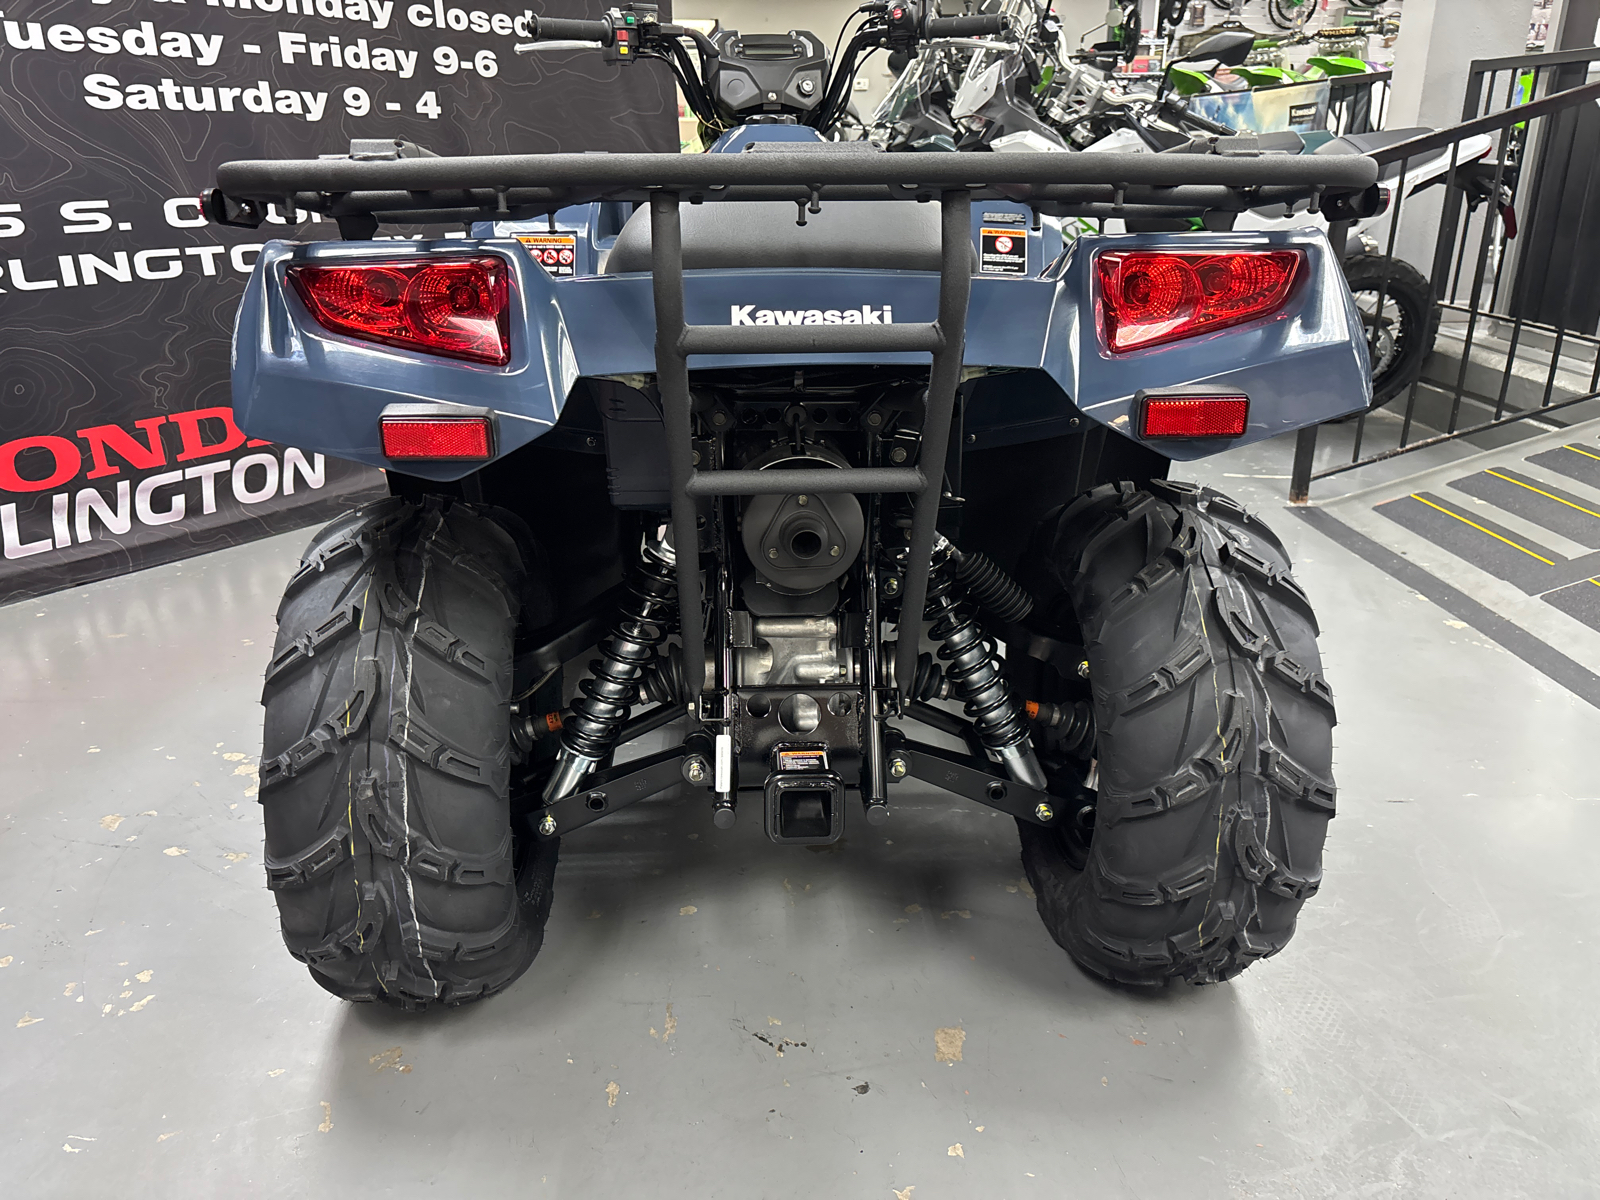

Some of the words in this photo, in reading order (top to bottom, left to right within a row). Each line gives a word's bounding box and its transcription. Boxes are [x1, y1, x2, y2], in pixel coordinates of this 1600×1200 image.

[206, 0, 394, 29] onday
[407, 0, 534, 38] closed
[0, 11, 224, 66] uesday
[278, 31, 418, 79] Friday
[433, 46, 499, 78] 9-6
[83, 73, 328, 122] Saturday
[343, 86, 371, 117] 9
[415, 91, 442, 119] 4
[59, 200, 133, 234] S.
[731, 304, 893, 327] Kawasaki
[0, 406, 274, 493] OND
[0, 446, 326, 560] LINGTON
